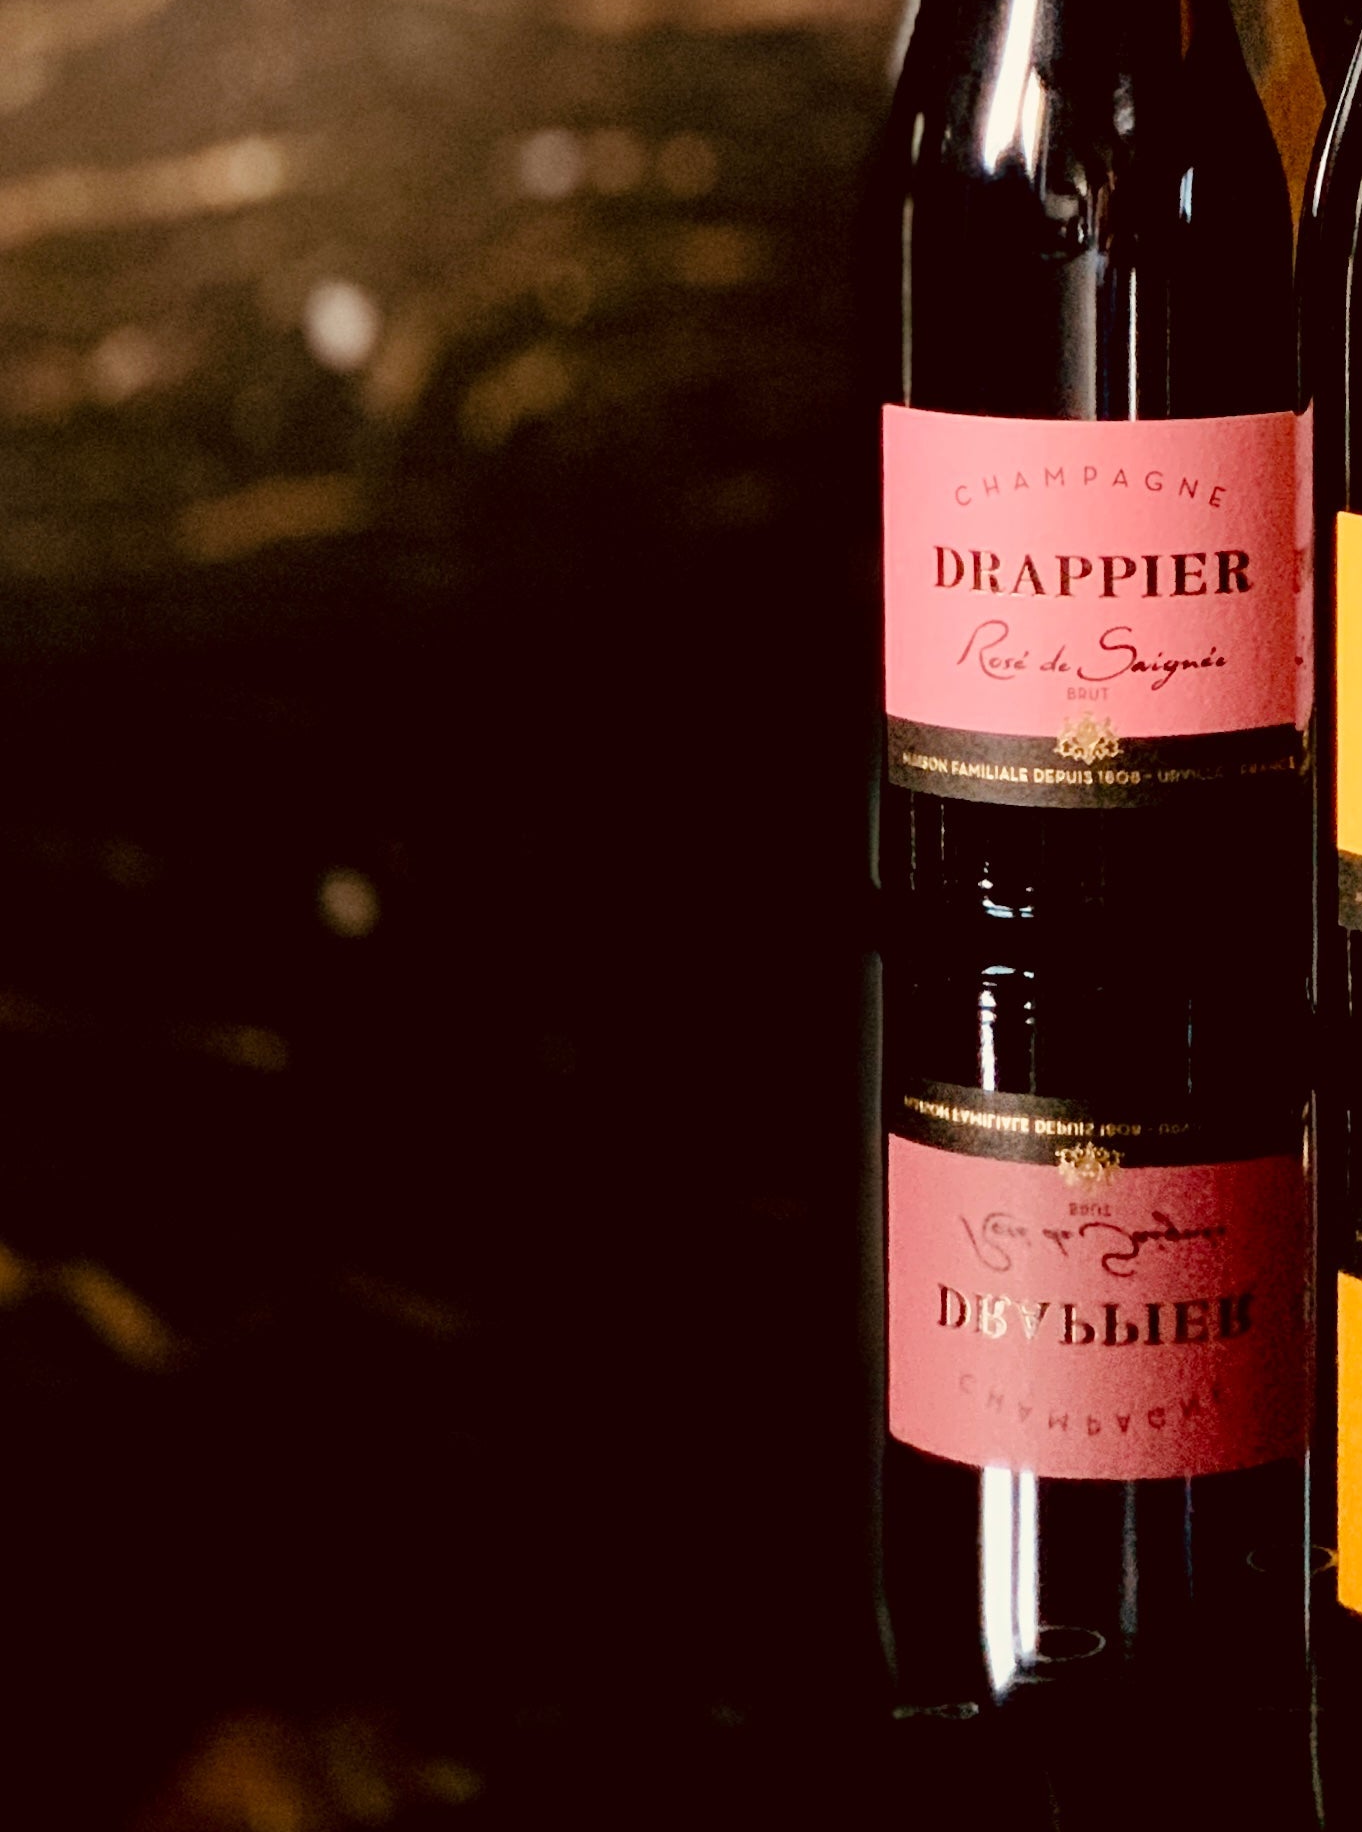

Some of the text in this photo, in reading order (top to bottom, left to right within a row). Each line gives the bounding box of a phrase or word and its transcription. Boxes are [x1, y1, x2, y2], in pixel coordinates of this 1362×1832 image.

[955, 465, 1227, 509] CHAMPAGNE
[933, 544, 1254, 598] DRAPPIER
[957, 619, 1227, 691] Rosé de Saignée
[1067, 687, 1109, 701] BRUT
[952, 759, 1028, 784] FAMILIALE
[1033, 767, 1093, 785] DEPUIS
